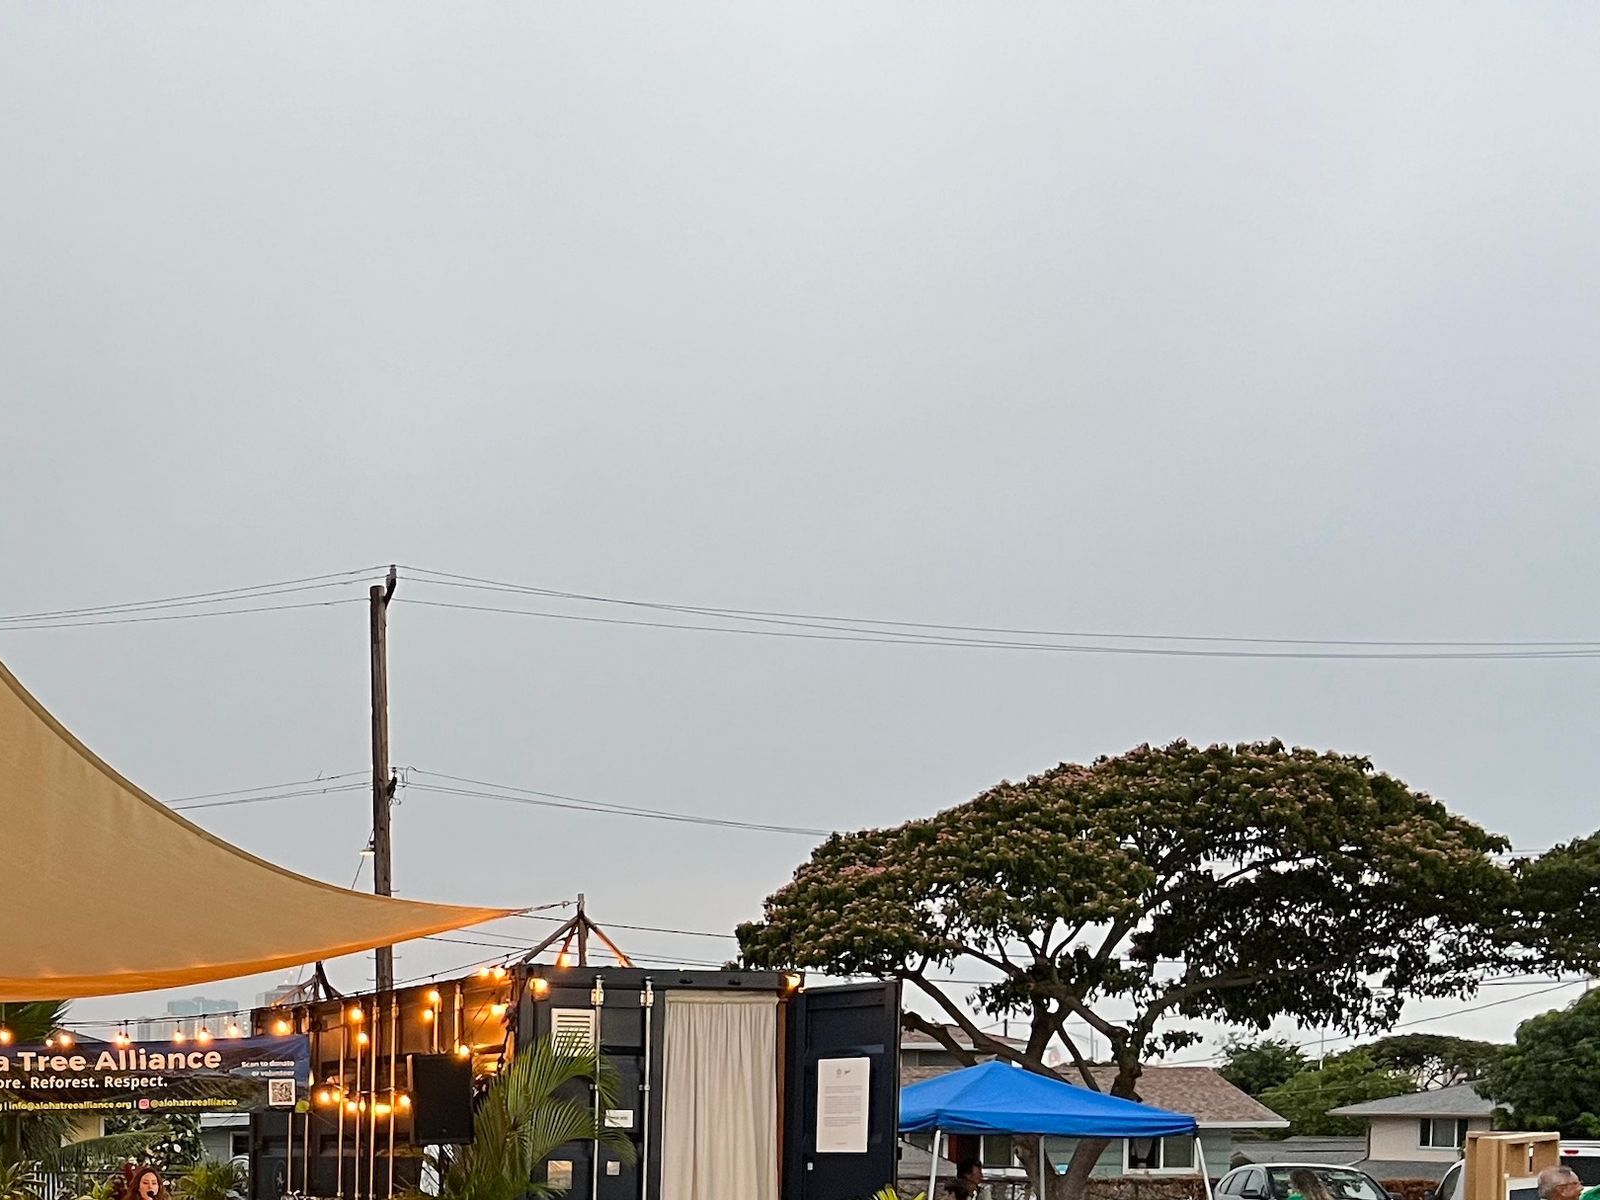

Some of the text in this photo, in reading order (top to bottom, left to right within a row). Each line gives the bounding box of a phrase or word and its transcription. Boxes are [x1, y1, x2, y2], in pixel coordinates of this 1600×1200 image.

[17, 1051, 87, 1072] Tree
[95, 1048, 222, 1071] Alliance
[269, 1059, 295, 1067] donate
[260, 1069, 295, 1077] volunteer
[30, 1075, 100, 1089] Reforest.
[104, 1075, 168, 1090] Respect.
[8, 1100, 132, 1111] info@alohatreealliance.org
[150, 1097, 238, 1108] @alohatreealliance
